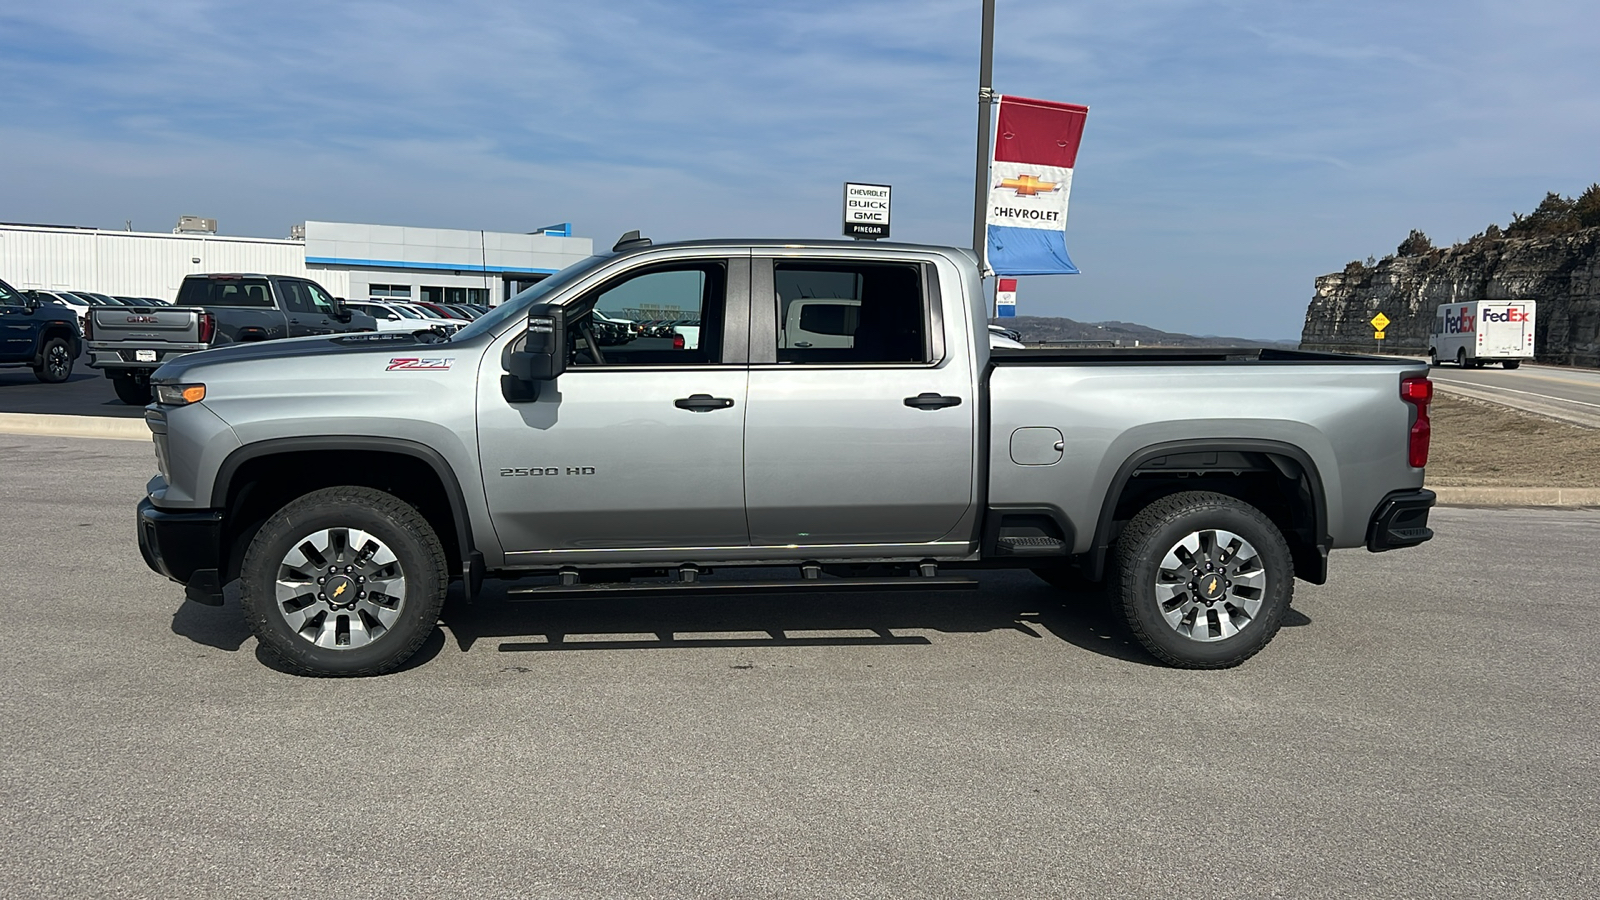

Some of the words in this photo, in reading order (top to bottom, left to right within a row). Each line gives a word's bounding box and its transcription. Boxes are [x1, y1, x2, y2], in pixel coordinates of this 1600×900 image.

[850, 188, 887, 198] CHEVROLET
[849, 200, 887, 209] BUICK
[854, 212, 882, 221] GMC
[994, 206, 1059, 222] CHEVROLET
[853, 225, 882, 234] PINEGAR
[1445, 307, 1475, 333] FedEx
[1483, 308, 1529, 322] FedEx
[500, 466, 559, 477] 2500
[566, 466, 596, 476] HD
